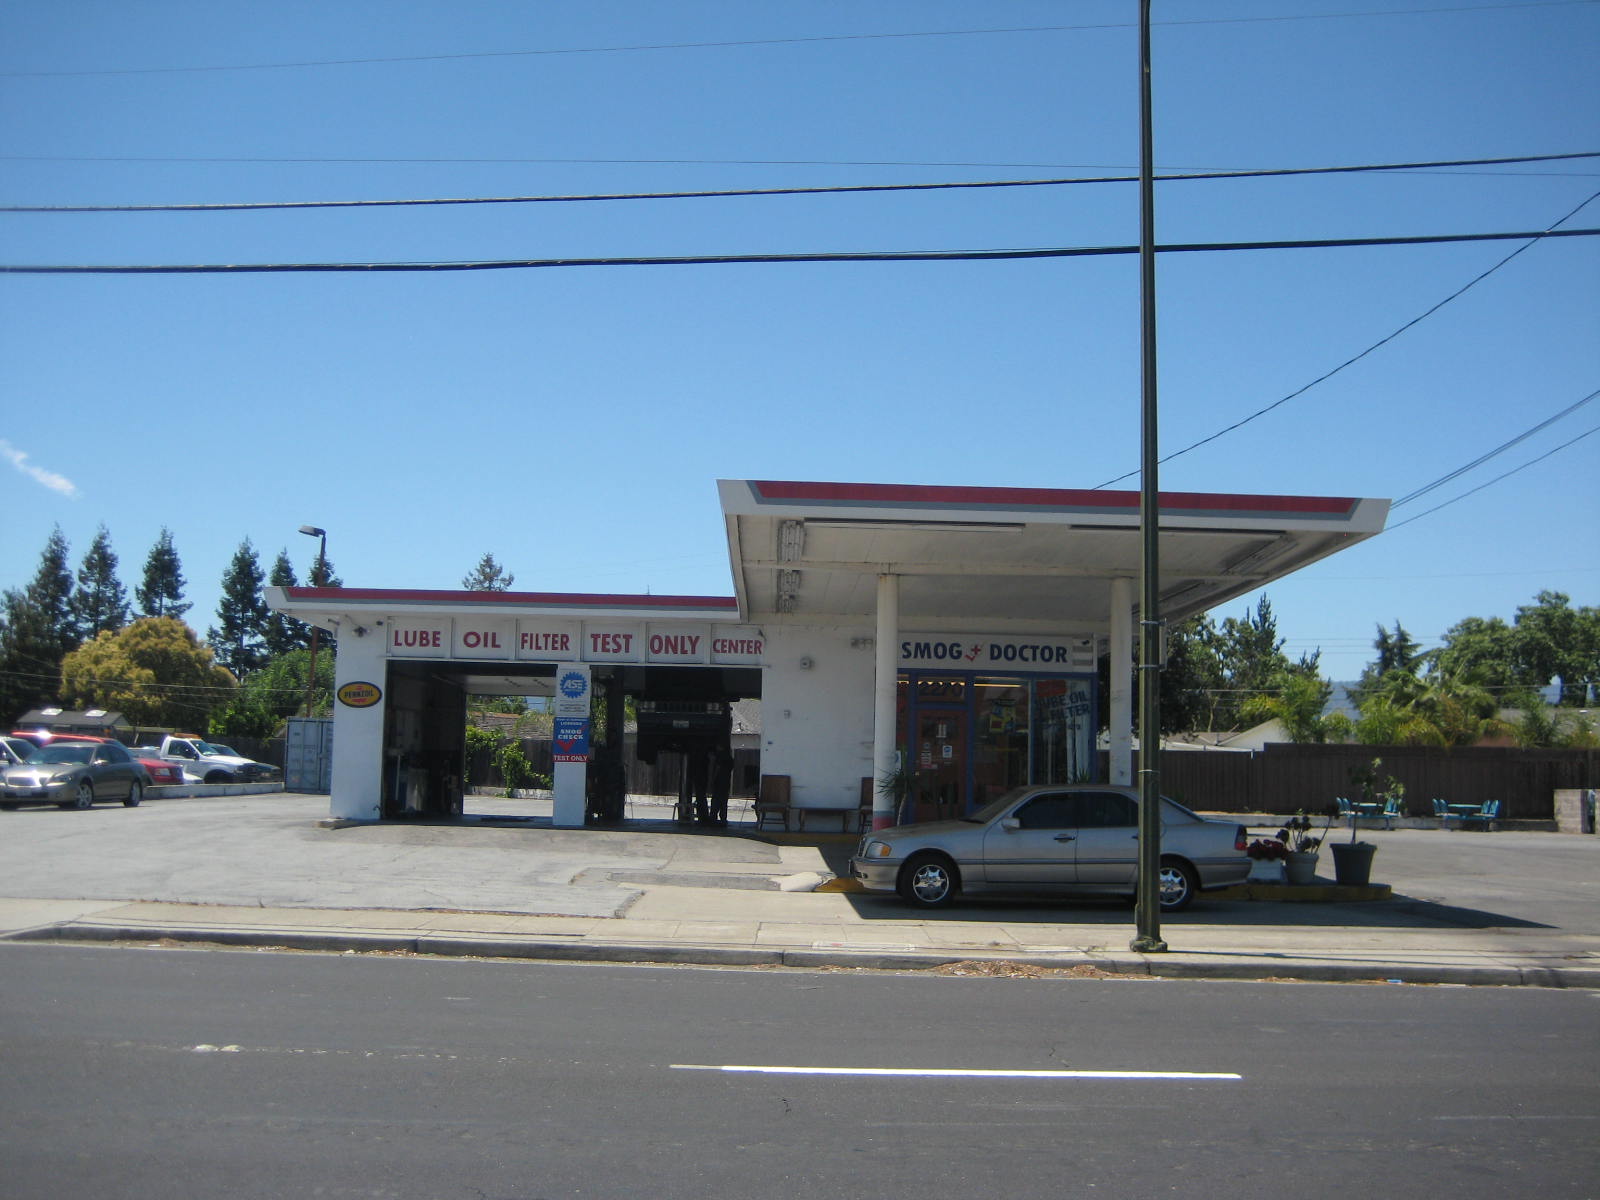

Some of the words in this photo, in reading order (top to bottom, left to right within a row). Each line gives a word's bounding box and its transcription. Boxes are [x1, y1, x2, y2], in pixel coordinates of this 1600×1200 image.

[394, 630, 441, 648] LUBE
[463, 631, 501, 649] OIL
[520, 632, 570, 651] FILTER
[590, 633, 633, 654] TEST
[649, 634, 700, 655] ONLY
[712, 638, 763, 655] CENTER
[901, 642, 963, 660] SMOG
[989, 644, 1068, 663] DOCTOR
[564, 680, 582, 689] ASE
